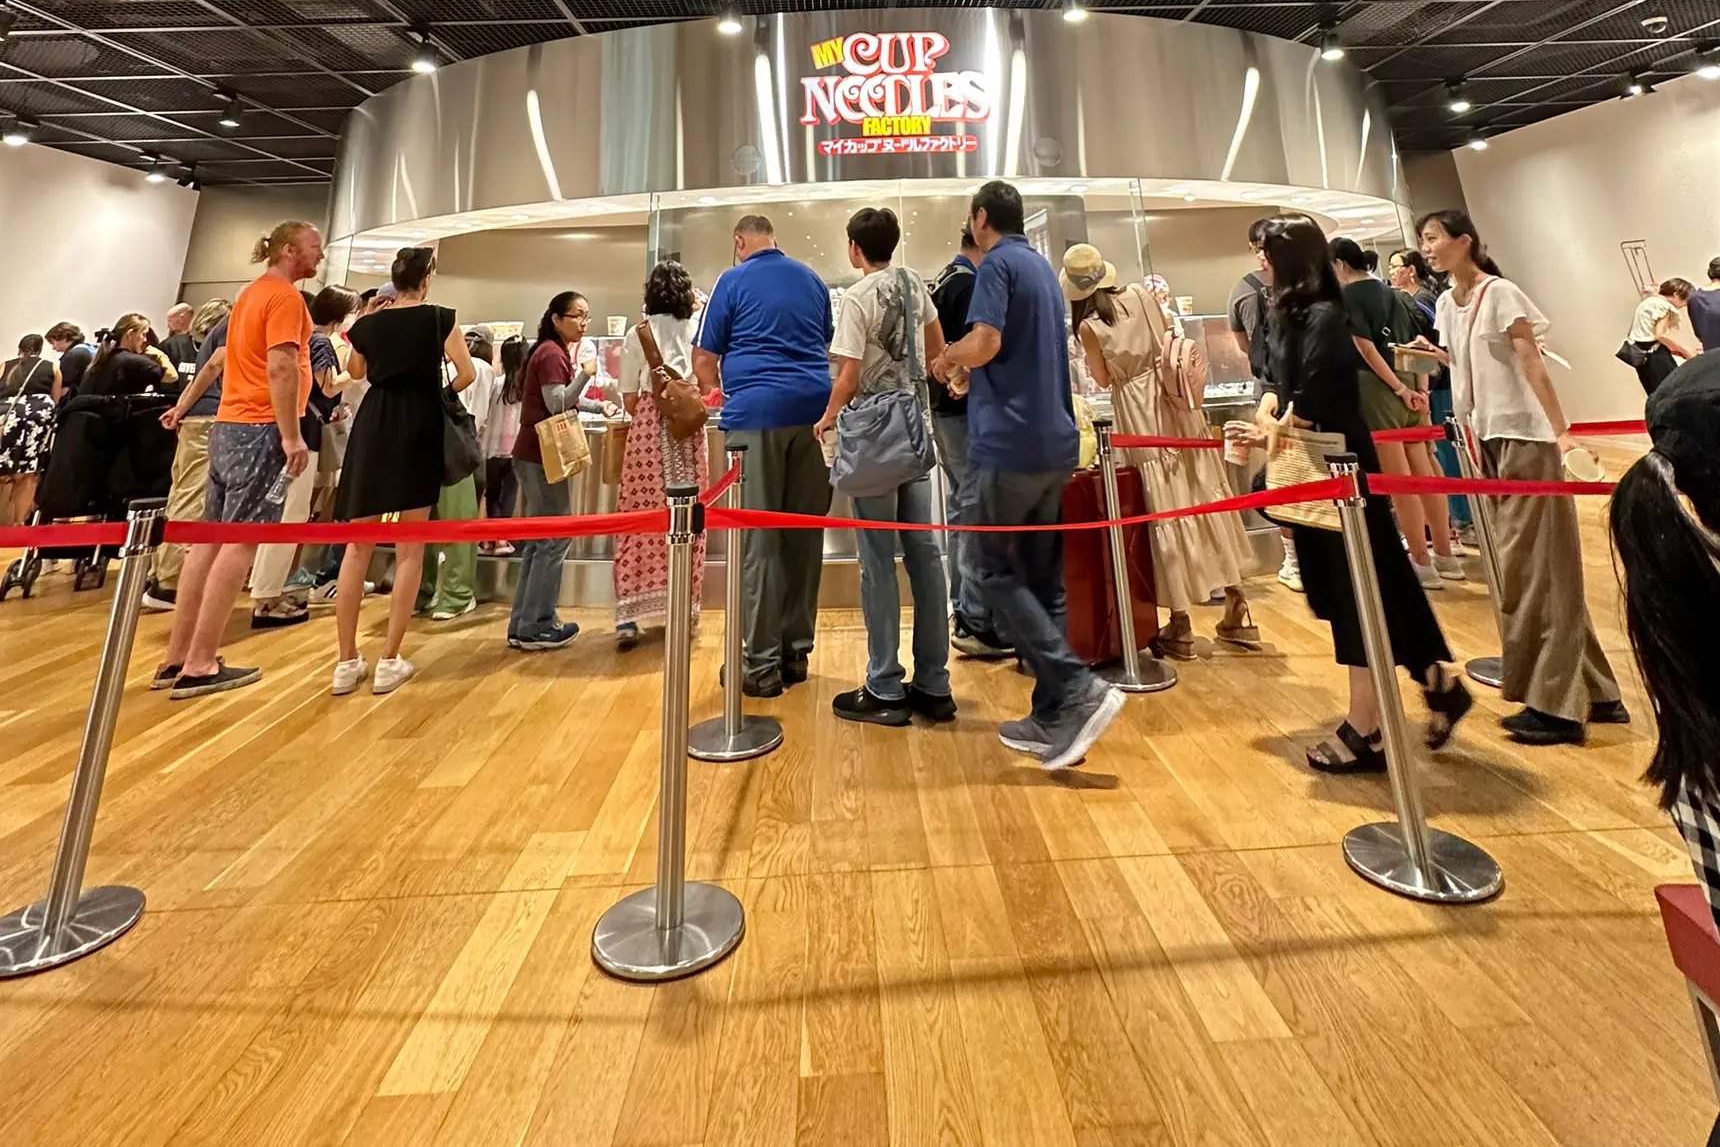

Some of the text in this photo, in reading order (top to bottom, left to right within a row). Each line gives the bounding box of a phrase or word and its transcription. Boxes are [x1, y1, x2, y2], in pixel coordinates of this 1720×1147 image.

[811, 32, 950, 76] MY CUP
[800, 71, 990, 125] NOODLES
[862, 116, 931, 136] FACTORY
